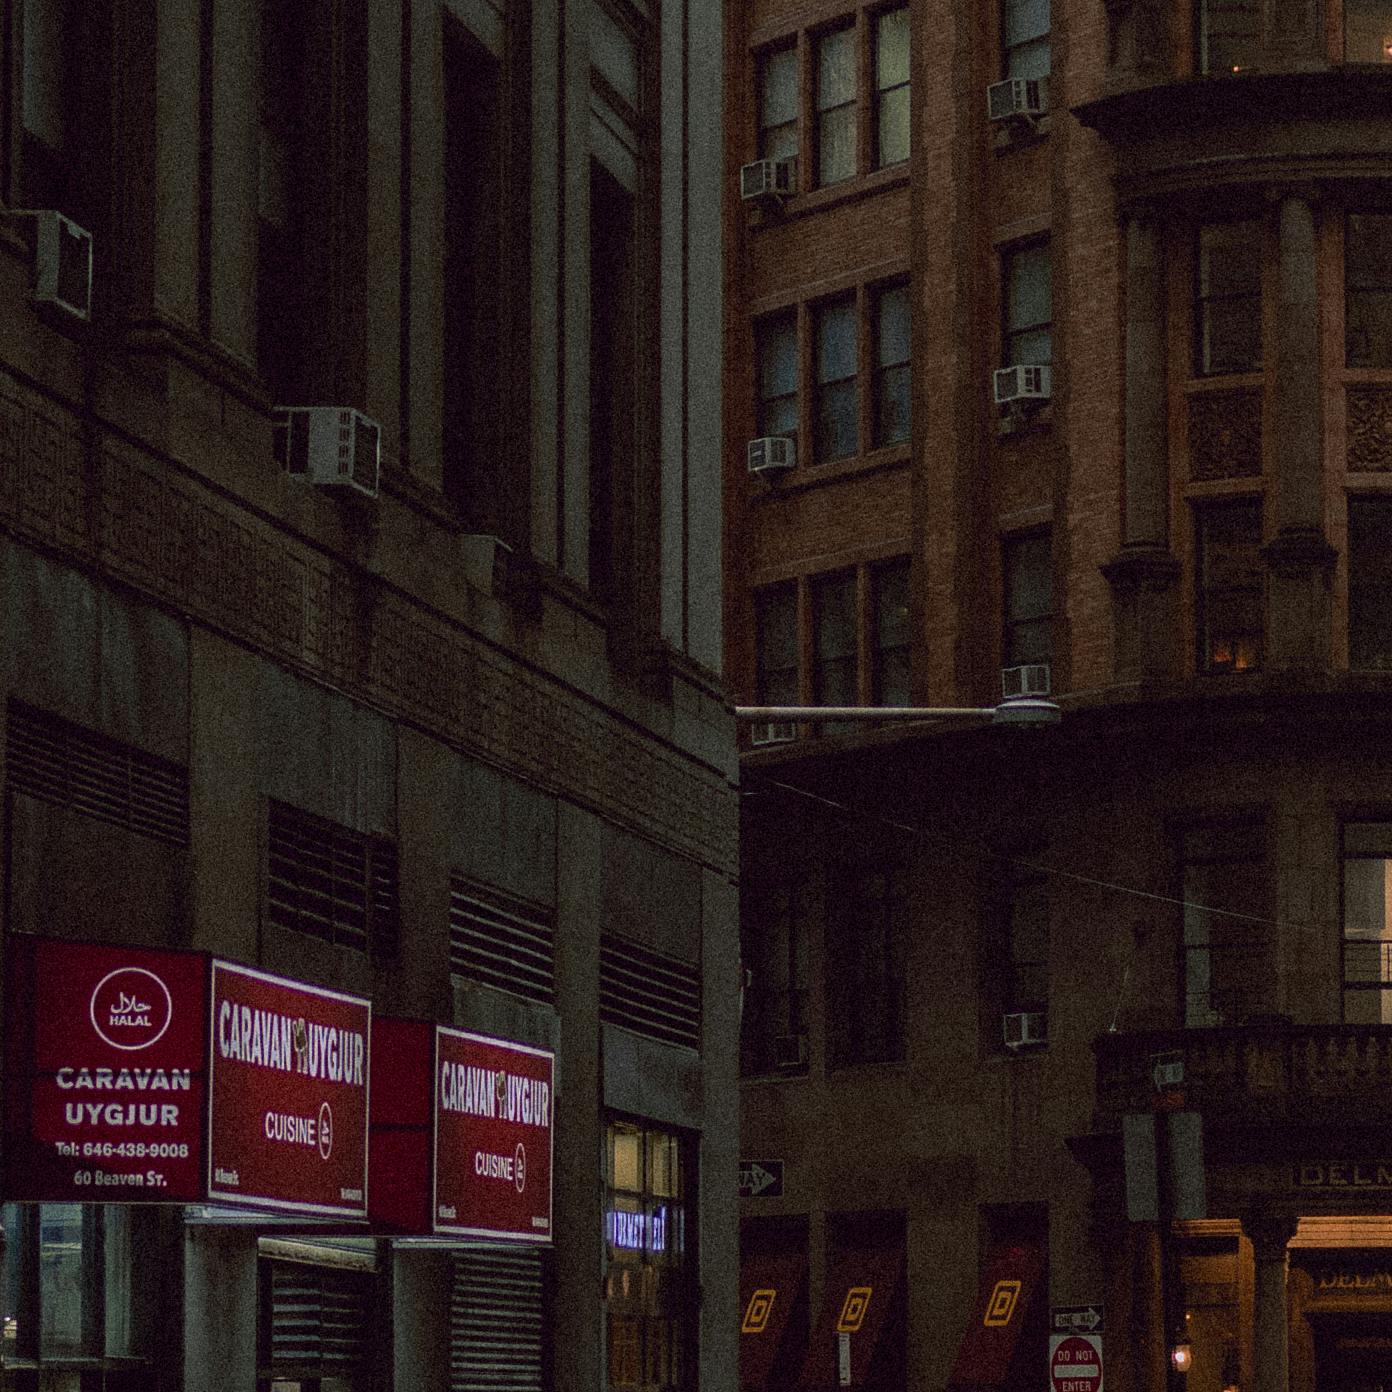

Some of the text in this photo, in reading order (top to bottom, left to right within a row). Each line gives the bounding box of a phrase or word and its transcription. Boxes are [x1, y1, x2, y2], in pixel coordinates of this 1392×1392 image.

[109, 1015, 152, 1026] HALAL
[219, 1000, 364, 1086] CARAVAN UYGJUR
[56, 1067, 191, 1090] CARAVAN
[441, 1061, 549, 1127] CARAVAN UYGJUR
[65, 1103, 180, 1126] UYGJUR
[265, 1112, 316, 1145] CUISINE
[55, 1142, 189, 1158] Tel: 646-438-9008
[475, 1151, 513, 1181] CUISINE
[74, 1171, 92, 1186] 60
[1057, 1350, 1093, 1361] DO NOT
[1062, 1381, 1092, 1392] ENTER
